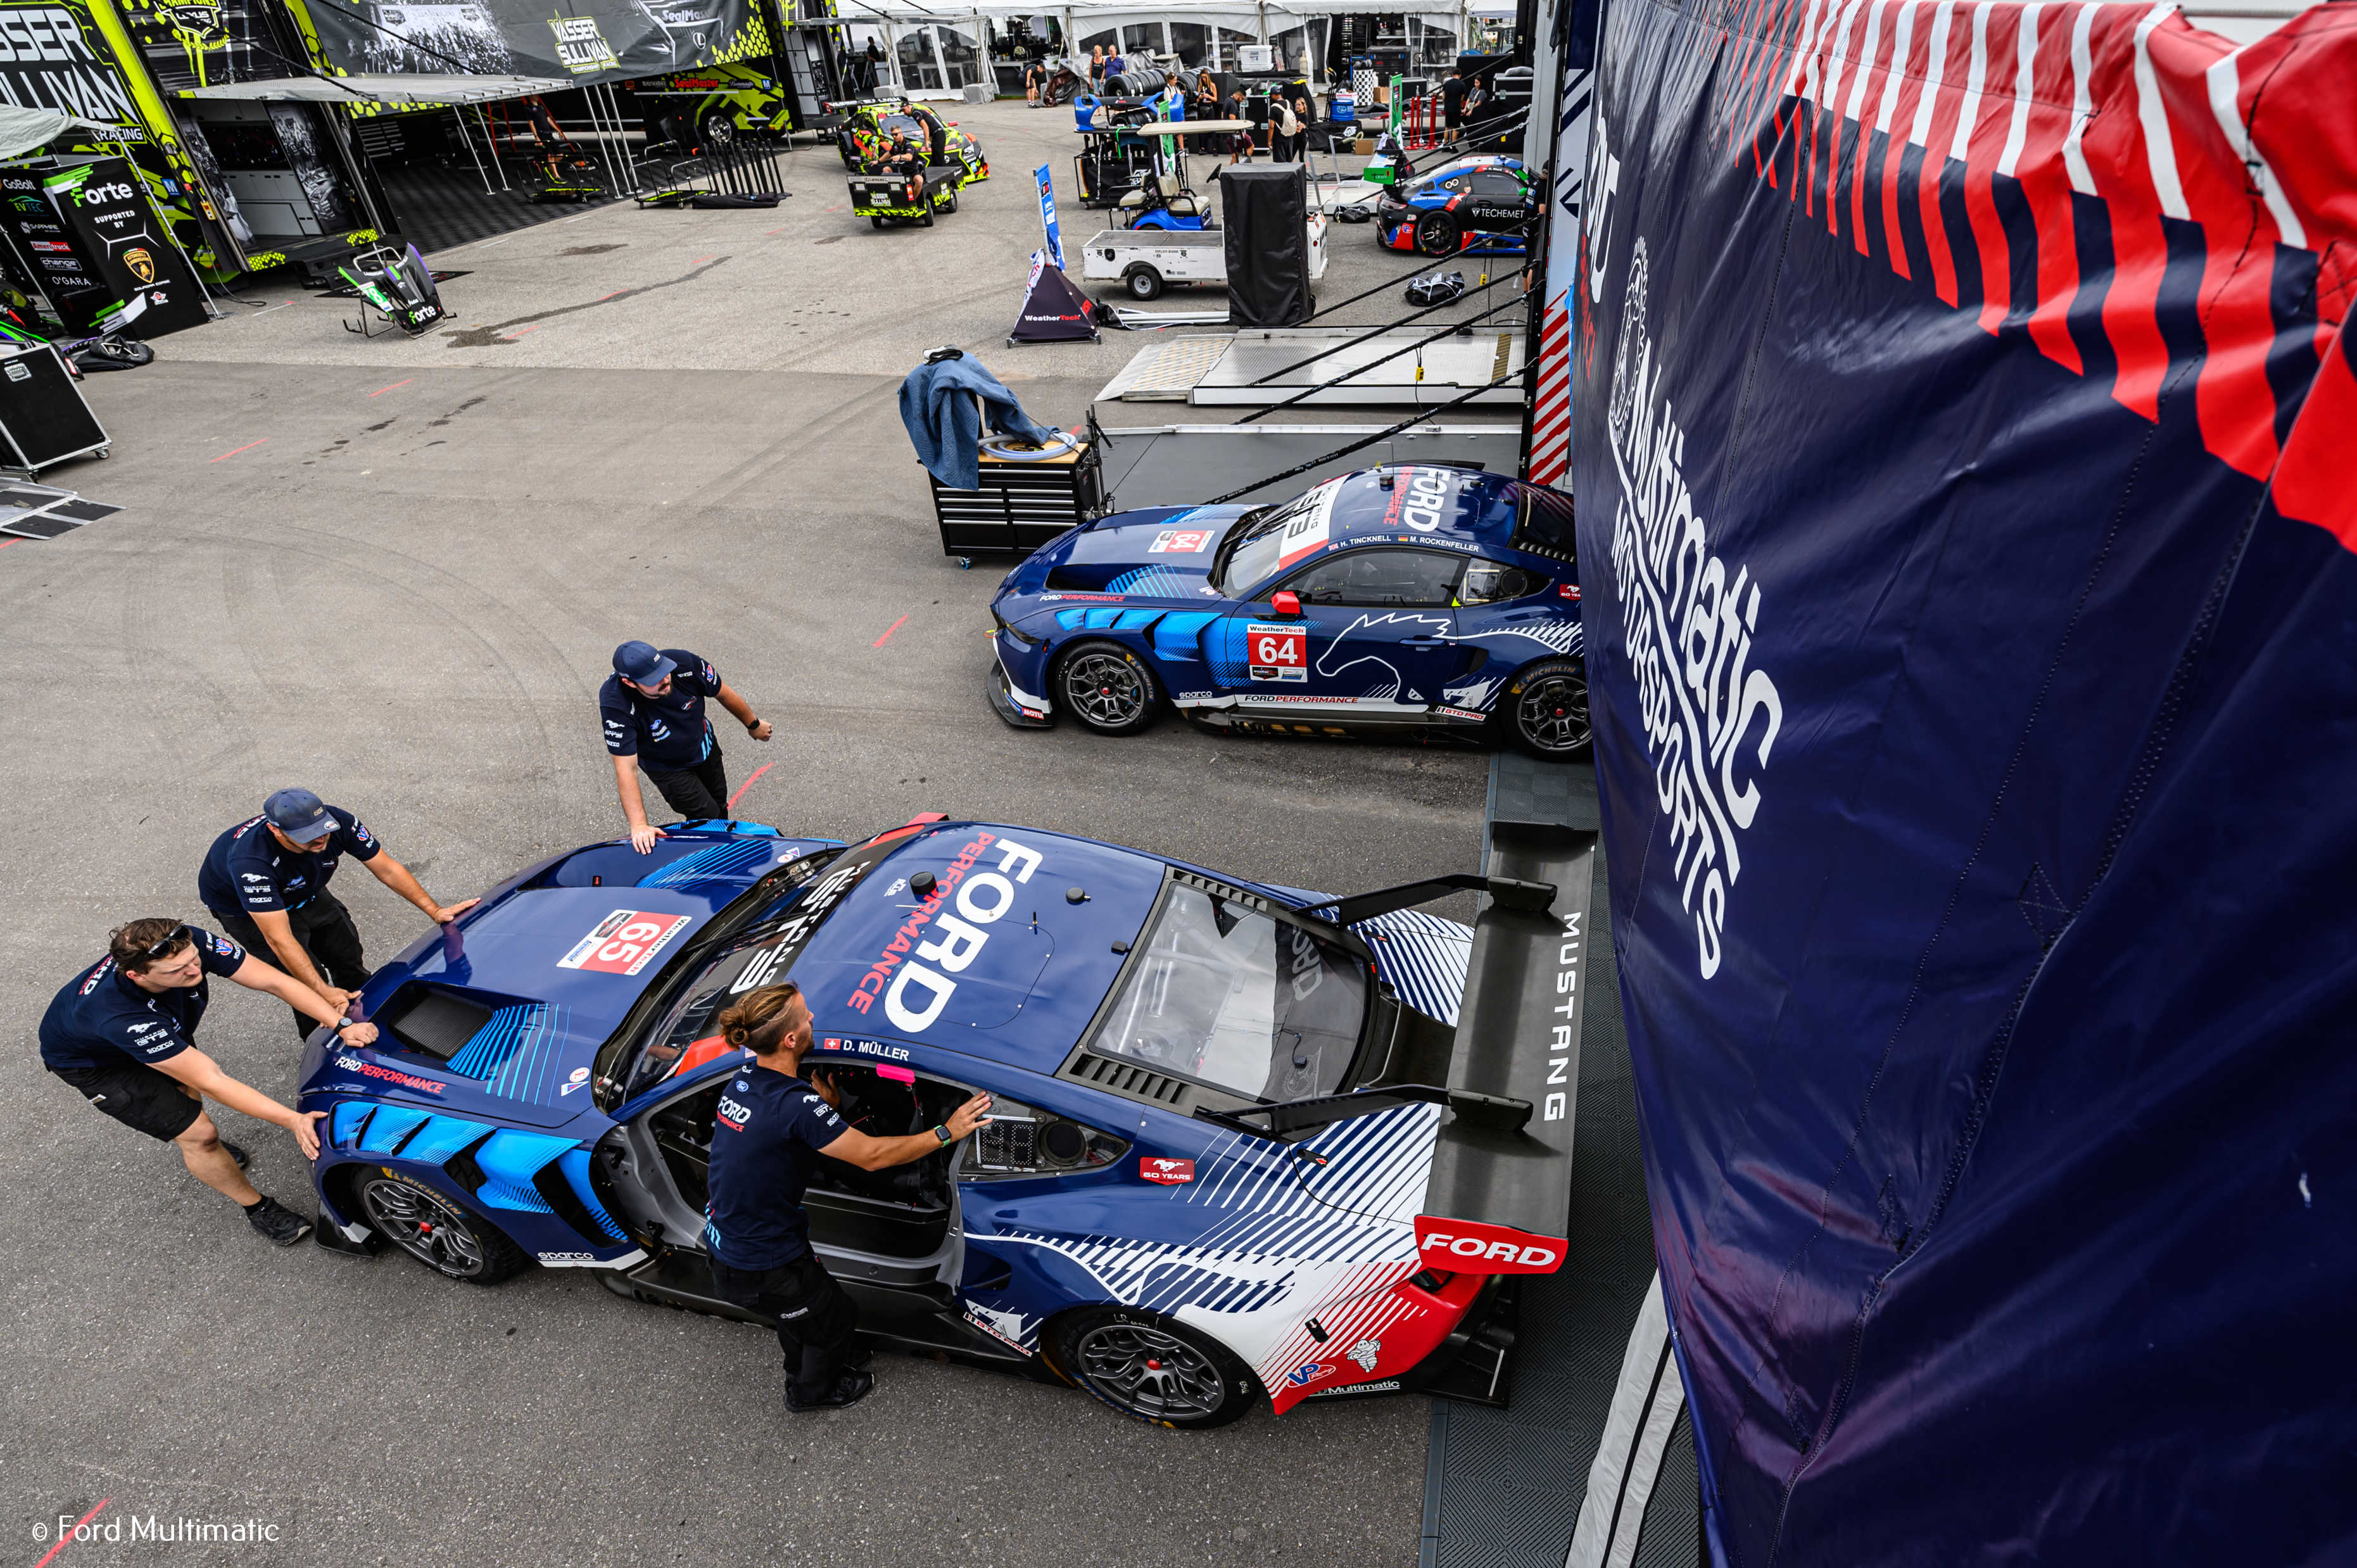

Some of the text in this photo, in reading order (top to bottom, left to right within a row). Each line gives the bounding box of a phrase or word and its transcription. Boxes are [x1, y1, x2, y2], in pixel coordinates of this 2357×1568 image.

[550, 19, 600, 44] VASSER
[557, 39, 616, 65] SULLIVAN
[674, 78, 719, 89] SealMaster
[99, 128, 143, 141] RACING
[3, 179, 36, 191] GoBolt
[70, 182, 133, 208] Forte
[94, 210, 135, 224] SUPPORTED
[52, 276, 91, 286] O'GARA
[408, 305, 436, 324] Forte
[1403, 466, 1451, 532] FORD
[1170, 533, 1200, 549] 64
[1349, 535, 1391, 545] TINCKNELL
[1420, 537, 1479, 552] ROCKENFELLER
[1626, 336, 1783, 830] Multimatic
[1258, 636, 1298, 664] 64
[1526, 666, 1576, 682] MICHELIN
[1179, 690, 1213, 699] sparco
[1611, 495, 1726, 980] MOTORSPORTS
[847, 831, 996, 1015] PERFORMANCE
[598, 922, 661, 963] 65
[630, 918, 688, 972] WeatherTech
[885, 838, 1043, 1033] FORD
[1544, 911, 1582, 1121] MUSTANG
[146, 1040, 175, 1054] sparco
[842, 1040, 910, 1061] D. MÜLLER
[717, 1096, 751, 1123] FORD
[401, 1175, 462, 1217] MICHELIN
[537, 1251, 595, 1263] sparco
[1419, 1233, 1557, 1267] FORD
[1287, 1363, 1319, 1385] VP
[1327, 1381, 1400, 1394] Multimatic
